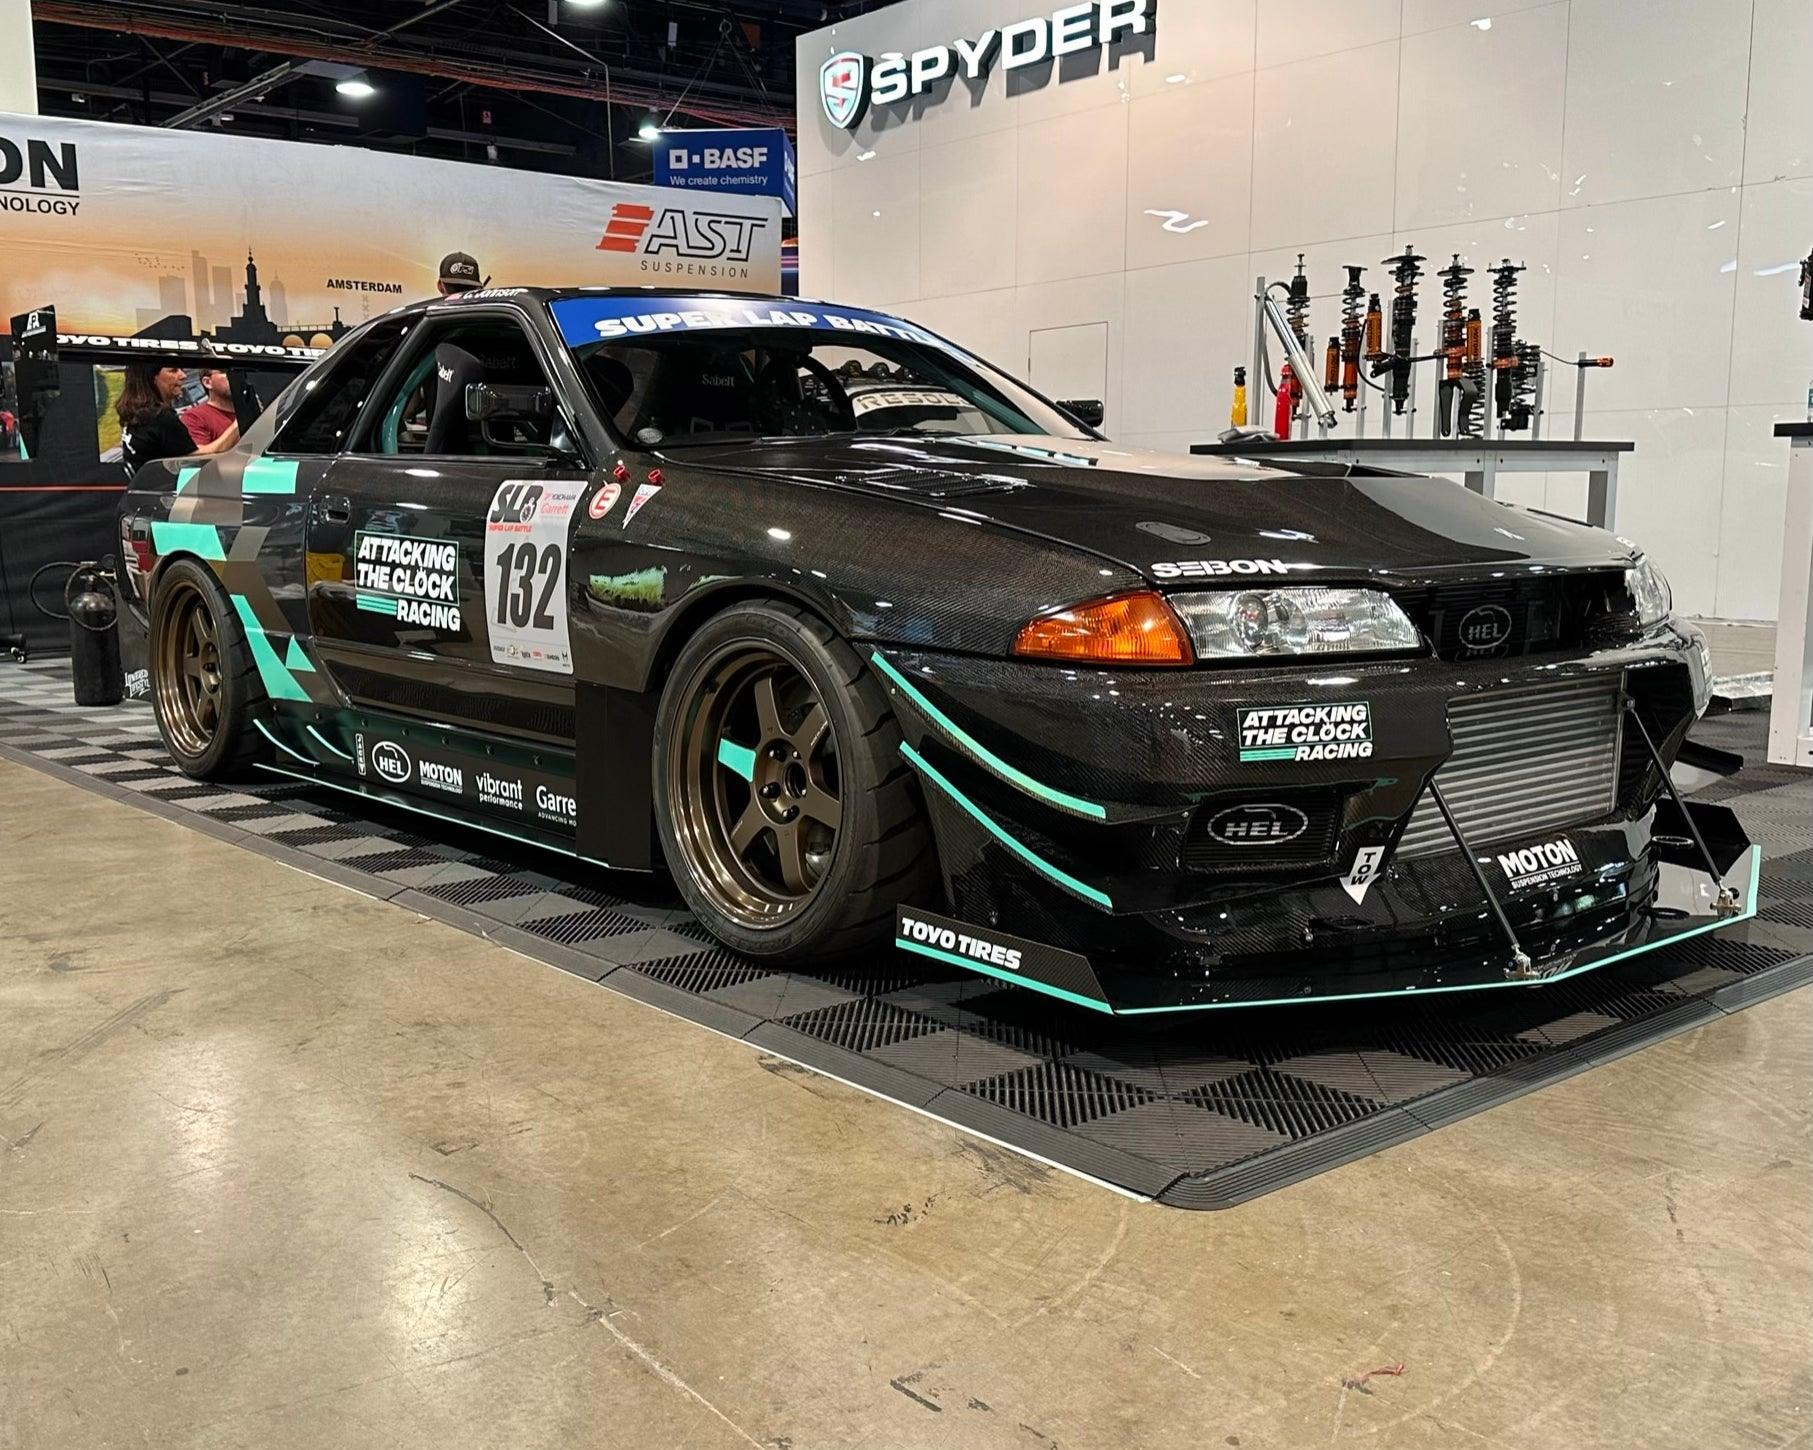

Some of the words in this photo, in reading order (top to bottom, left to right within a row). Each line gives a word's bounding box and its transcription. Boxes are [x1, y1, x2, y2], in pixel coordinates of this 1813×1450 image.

[870, 0, 1148, 106] SPYDER
[704, 148, 768, 169] BASF
[670, 175, 686, 186] We
[688, 176, 718, 186] create
[720, 174, 768, 186] chemistry
[644, 208, 768, 262] AST
[640, 260, 748, 279] SUSPENSION
[326, 278, 402, 294] AMSTERDAM
[594, 310, 738, 337] SUPER
[742, 310, 818, 326] LAP
[113, 337, 199, 350] TIRES
[212, 342, 286, 355] TOYO
[595, 489, 616, 511] E
[358, 536, 456, 571] ATTACKING
[1151, 559, 1289, 578] SEBON
[358, 562, 391, 590] THE
[392, 567, 455, 600] CLOCK
[496, 543, 562, 630] 132
[397, 599, 460, 632] RACING
[1467, 622, 1502, 641] HEL
[1242, 705, 1367, 727] ATTACKING
[1242, 727, 1288, 746] THE
[1291, 722, 1368, 743] CLOCK
[1295, 742, 1373, 761] RACING
[379, 755, 405, 776] HEL
[419, 760, 463, 786] MOTON
[476, 772, 523, 800] vibrant
[480, 793, 523, 810] performance
[536, 785, 577, 816] Garre
[1224, 821, 1289, 836] HEL
[1350, 852, 1377, 886] TOW
[1497, 839, 1579, 878] MOTON
[1511, 873, 1549, 890] SUSPENSION
[902, 917, 956, 948] TOYO
[957, 934, 1022, 970] TIRES
